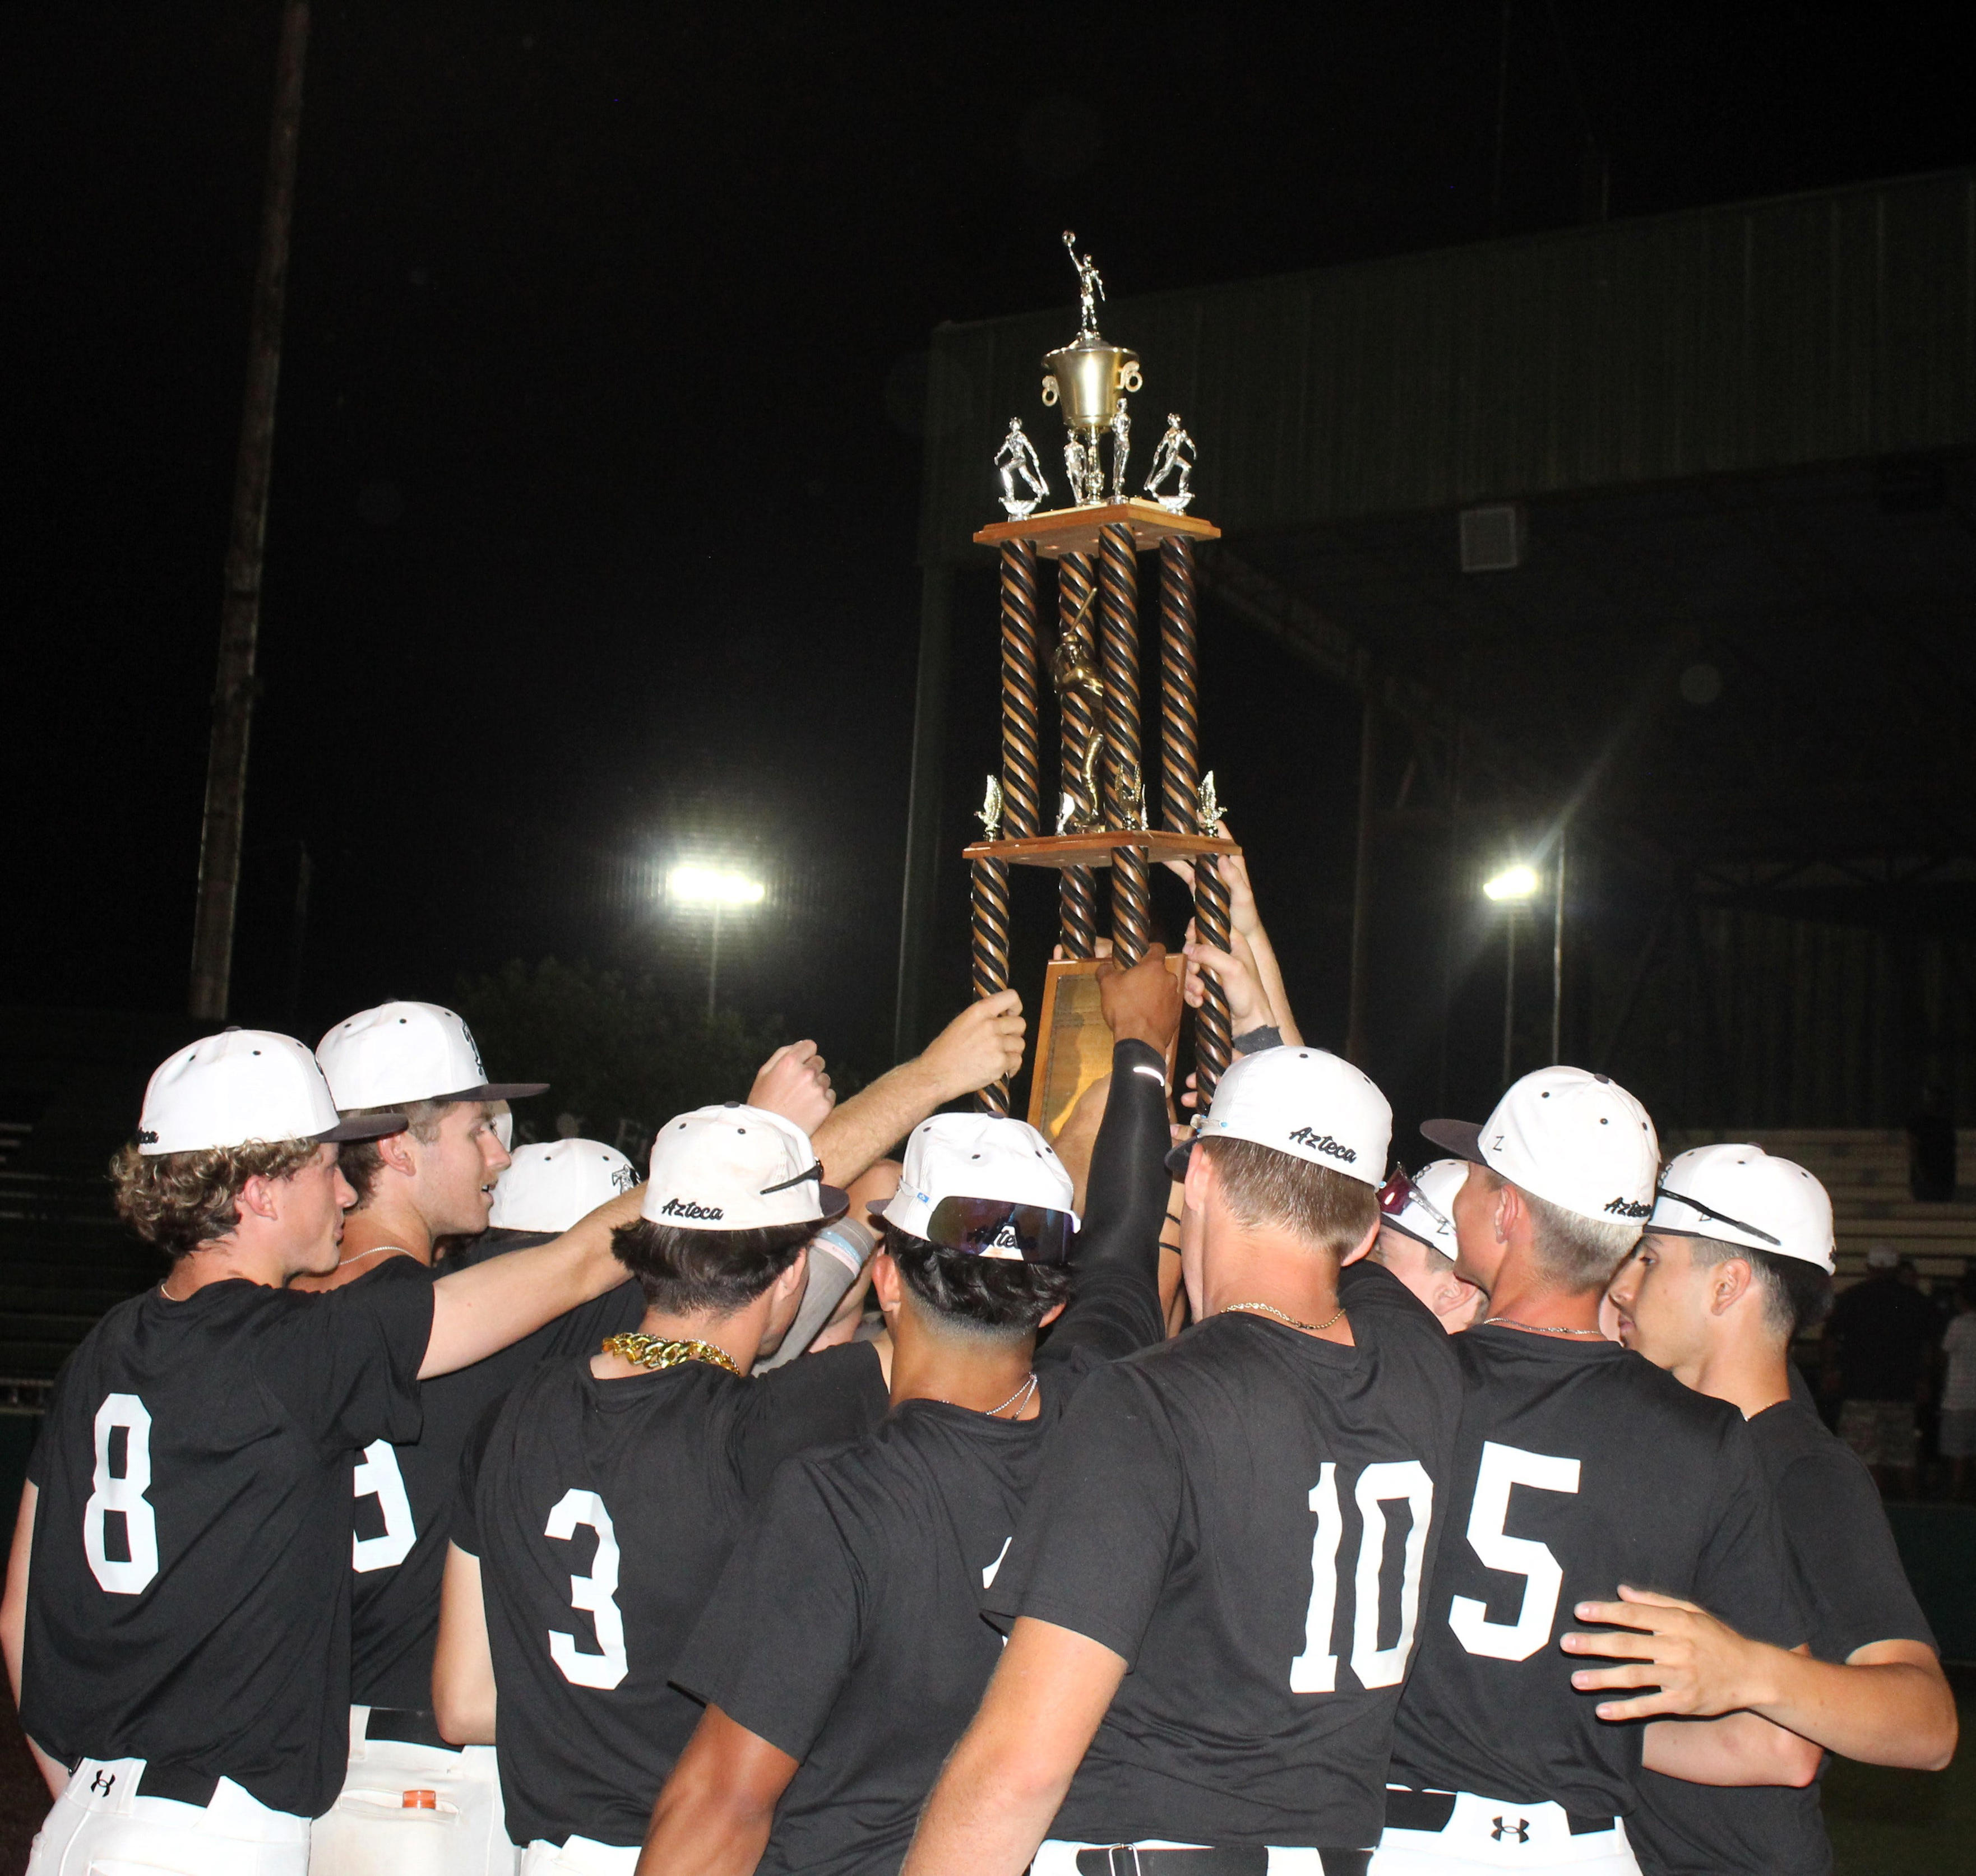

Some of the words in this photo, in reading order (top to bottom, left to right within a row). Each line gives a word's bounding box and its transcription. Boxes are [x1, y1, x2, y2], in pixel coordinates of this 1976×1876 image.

[661, 1198, 724, 1220] Azteca
[1289, 1127, 1357, 1164] Azteca
[1492, 1136, 1505, 1152] Z
[84, 1393, 159, 1595] 8
[544, 1488, 629, 1690] 3
[1289, 1460, 1434, 1693] 10
[1449, 1440, 1579, 1662] 5
